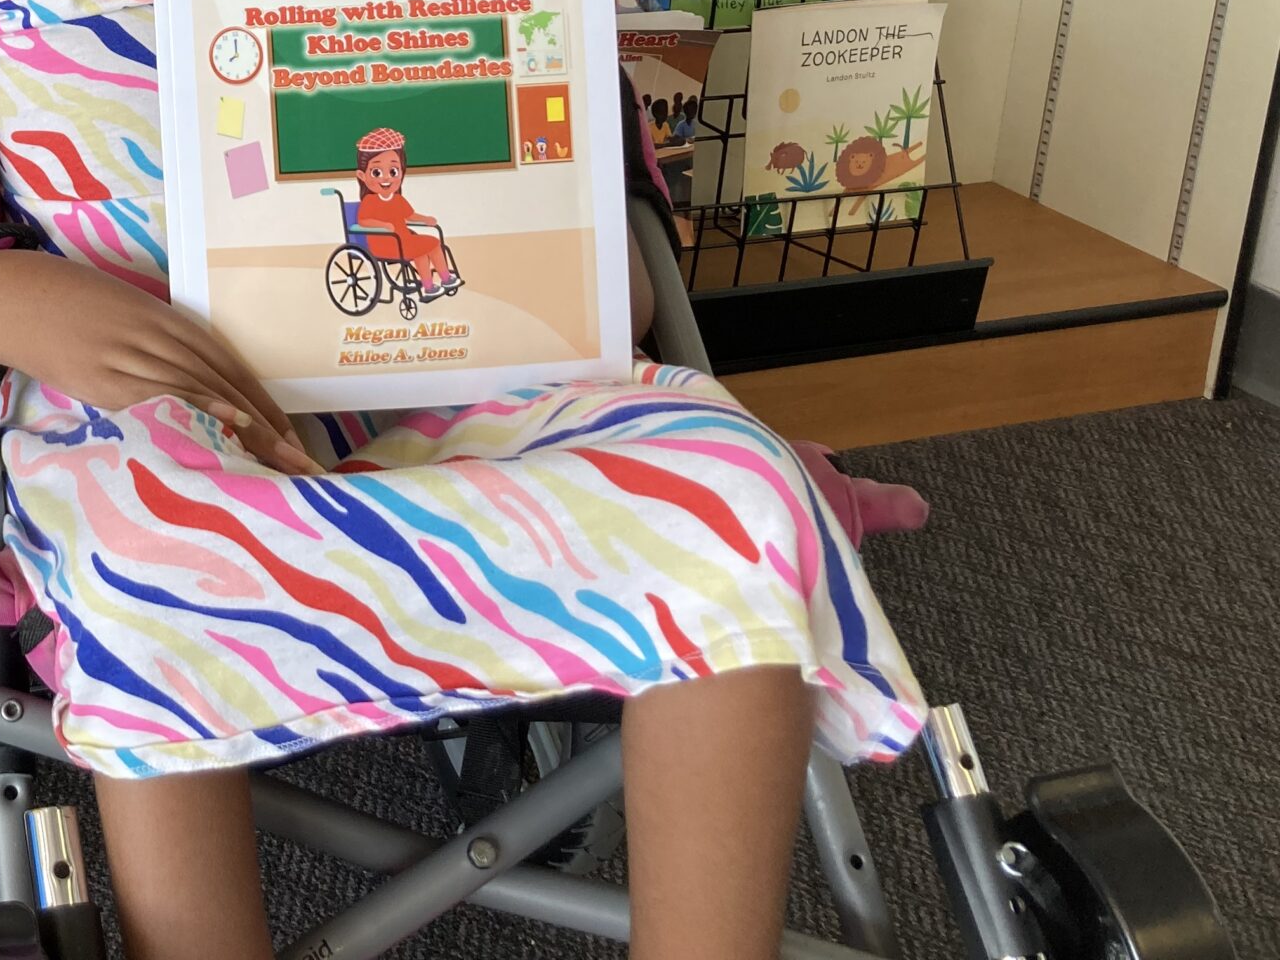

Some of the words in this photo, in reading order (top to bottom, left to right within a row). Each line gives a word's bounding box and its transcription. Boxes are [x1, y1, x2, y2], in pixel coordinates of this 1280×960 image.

[245, 5, 338, 28] Rolling
[341, 0, 403, 22] with
[306, 33, 382, 55] Khloe
[386, 30, 470, 51] Shines
[618, 31, 679, 48] Heart
[801, 27, 869, 46] LANDON
[875, 24, 908, 40] THE
[800, 45, 903, 67] ZOOKEEPER
[272, 65, 366, 90] Beyond
[370, 58, 513, 83] Boundaries
[343, 326, 410, 344] Megan
[412, 322, 469, 338] Allen
[338, 349, 391, 365] Khloe
[392, 348, 414, 362] A.
[416, 346, 467, 360] Jones
